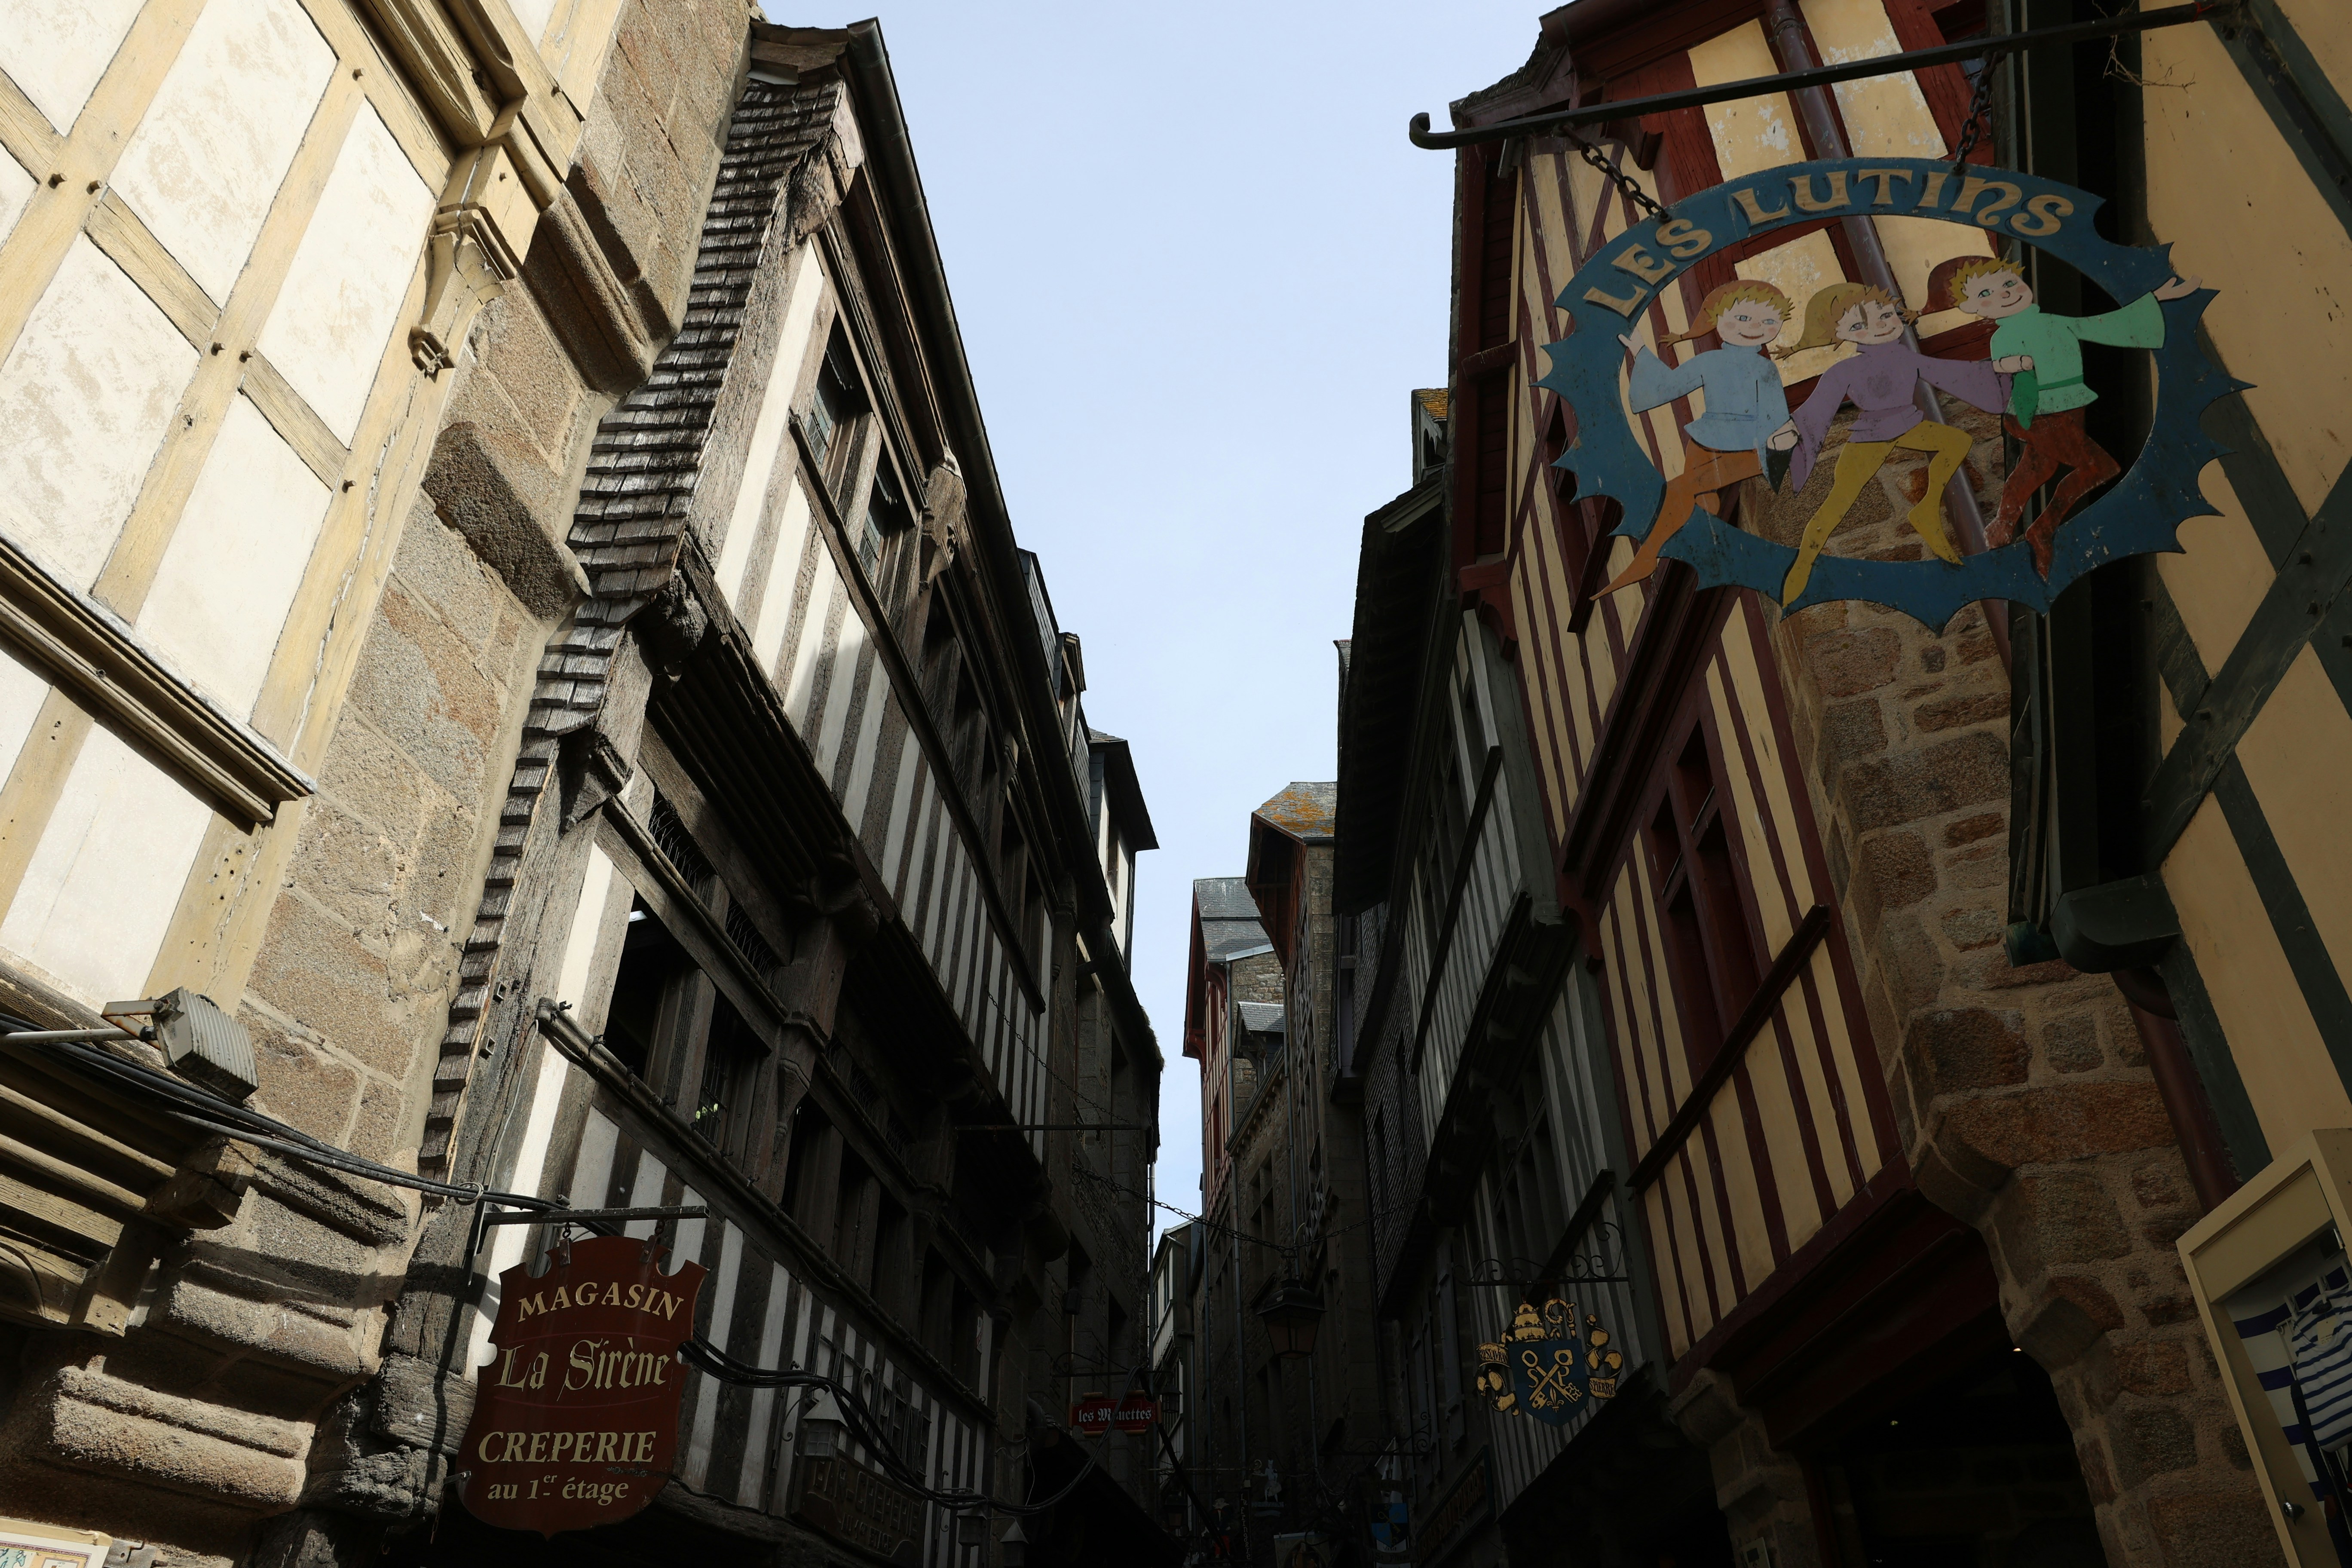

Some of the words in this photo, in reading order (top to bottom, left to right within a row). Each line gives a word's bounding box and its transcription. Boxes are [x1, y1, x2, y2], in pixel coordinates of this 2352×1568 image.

[1583, 218, 1712, 318] LES
[1733, 167, 2074, 237] LUTINS
[518, 1281, 684, 1323] MAGASIN
[494, 1344, 549, 1390] La
[557, 1337, 673, 1401] Sirène
[1078, 1409, 1094, 1423] les
[1097, 1407, 1152, 1422] Muettes
[478, 1431, 657, 1463] CREPERIE
[488, 1484, 518, 1500] au
[562, 1476, 629, 1506] étage
